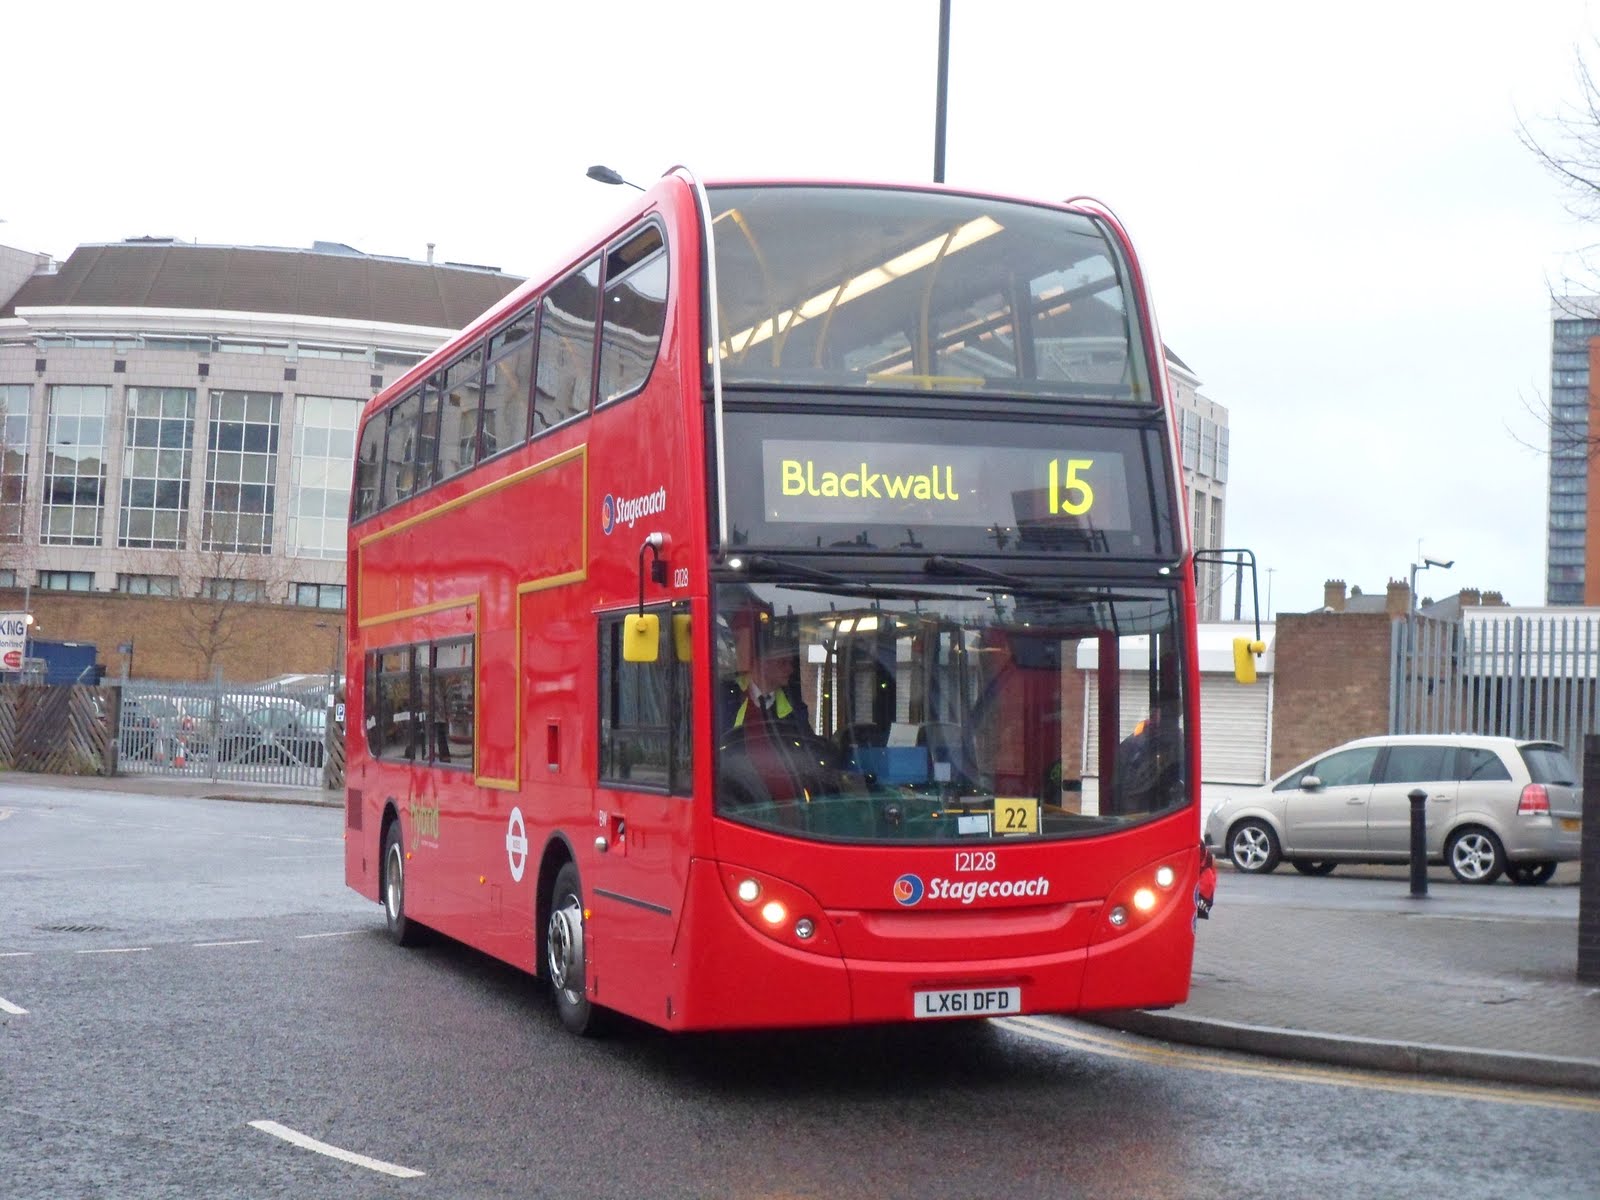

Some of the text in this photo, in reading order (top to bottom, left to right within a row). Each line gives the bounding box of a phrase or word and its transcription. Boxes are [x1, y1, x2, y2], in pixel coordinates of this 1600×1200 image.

[781, 460, 959, 501] Blackwall
[1048, 459, 1094, 515] 15
[615, 485, 666, 529] Stagecoach
[674, 567, 689, 588] 12128
[1004, 807, 1028, 829] 22
[955, 851, 996, 872] 12128
[928, 876, 1049, 904] Stagecoach
[925, 990, 1010, 1013] LX61 DFD
